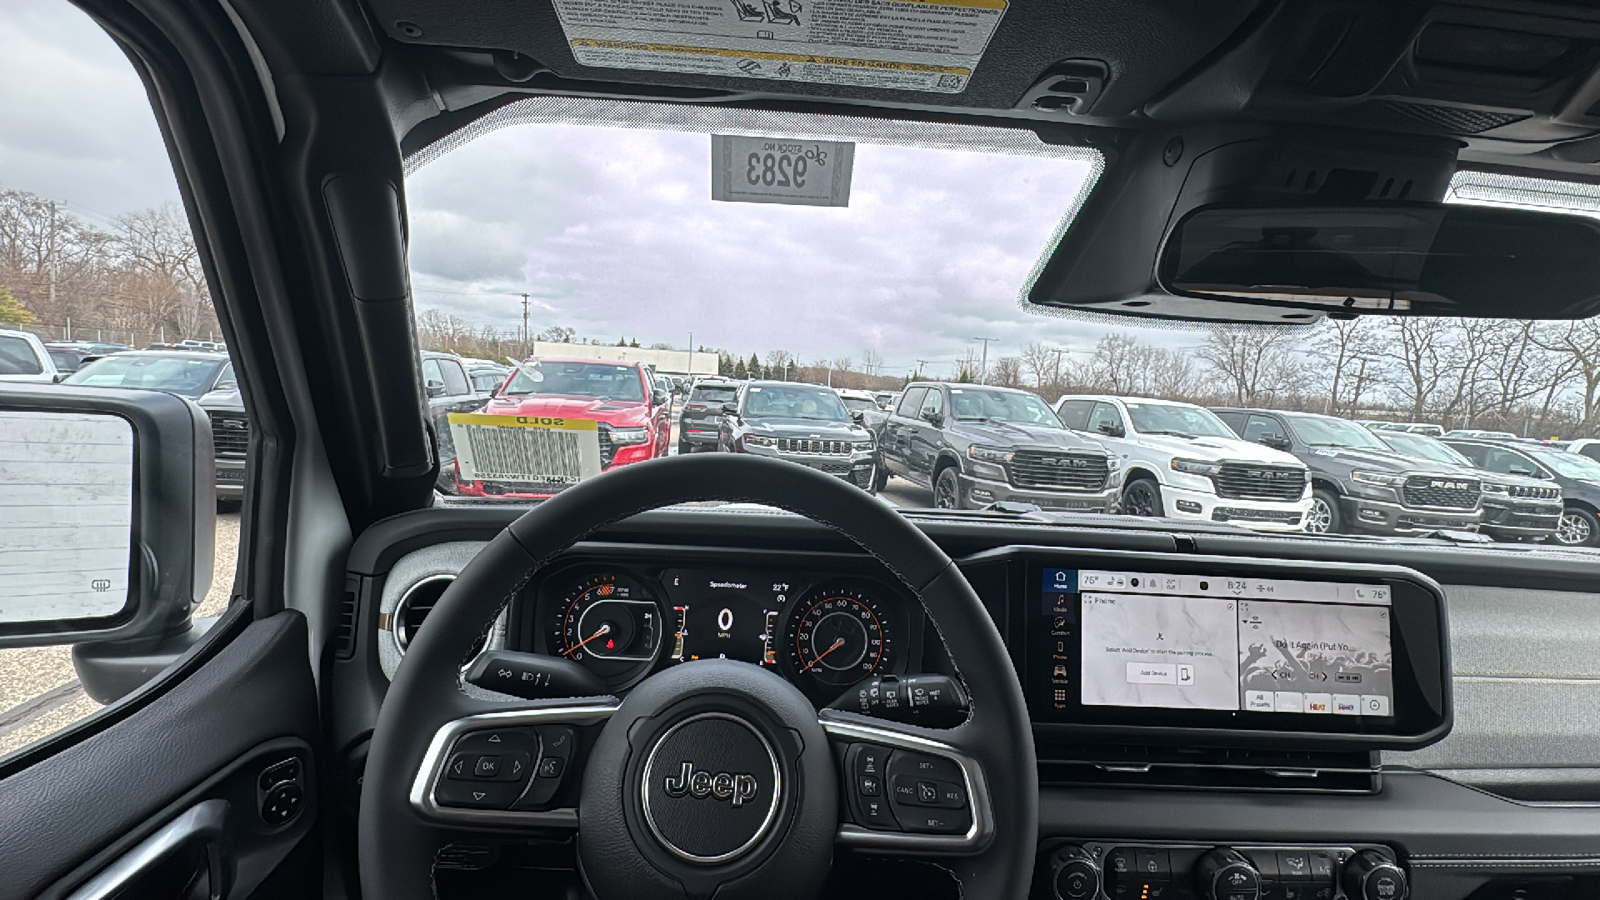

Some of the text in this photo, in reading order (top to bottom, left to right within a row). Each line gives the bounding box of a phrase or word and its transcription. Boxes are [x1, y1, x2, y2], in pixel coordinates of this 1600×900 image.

[824, 57, 848, 66] MISE
[1041, 458, 1088, 468] RAM
[1248, 470, 1290, 480] RAM
[1430, 480, 1469, 490] RAM
[709, 581, 748, 589] Speedometer
[1228, 580, 1247, 589] 8:24
[584, 593, 591, 601] 5
[1094, 597, 1116, 605] Phone
[568, 615, 574, 623] 3
[718, 607, 734, 631] 0
[861, 611, 871, 619] 80
[566, 628, 573, 636] 2
[799, 632, 809, 640] 20
[1296, 641, 1319, 650] Again
[1320, 641, 1336, 651] (Put
[576, 652, 583, 660] 0
[862, 662, 873, 670] 120
[482, 762, 495, 770] OK
[665, 762, 758, 806] Jeep
